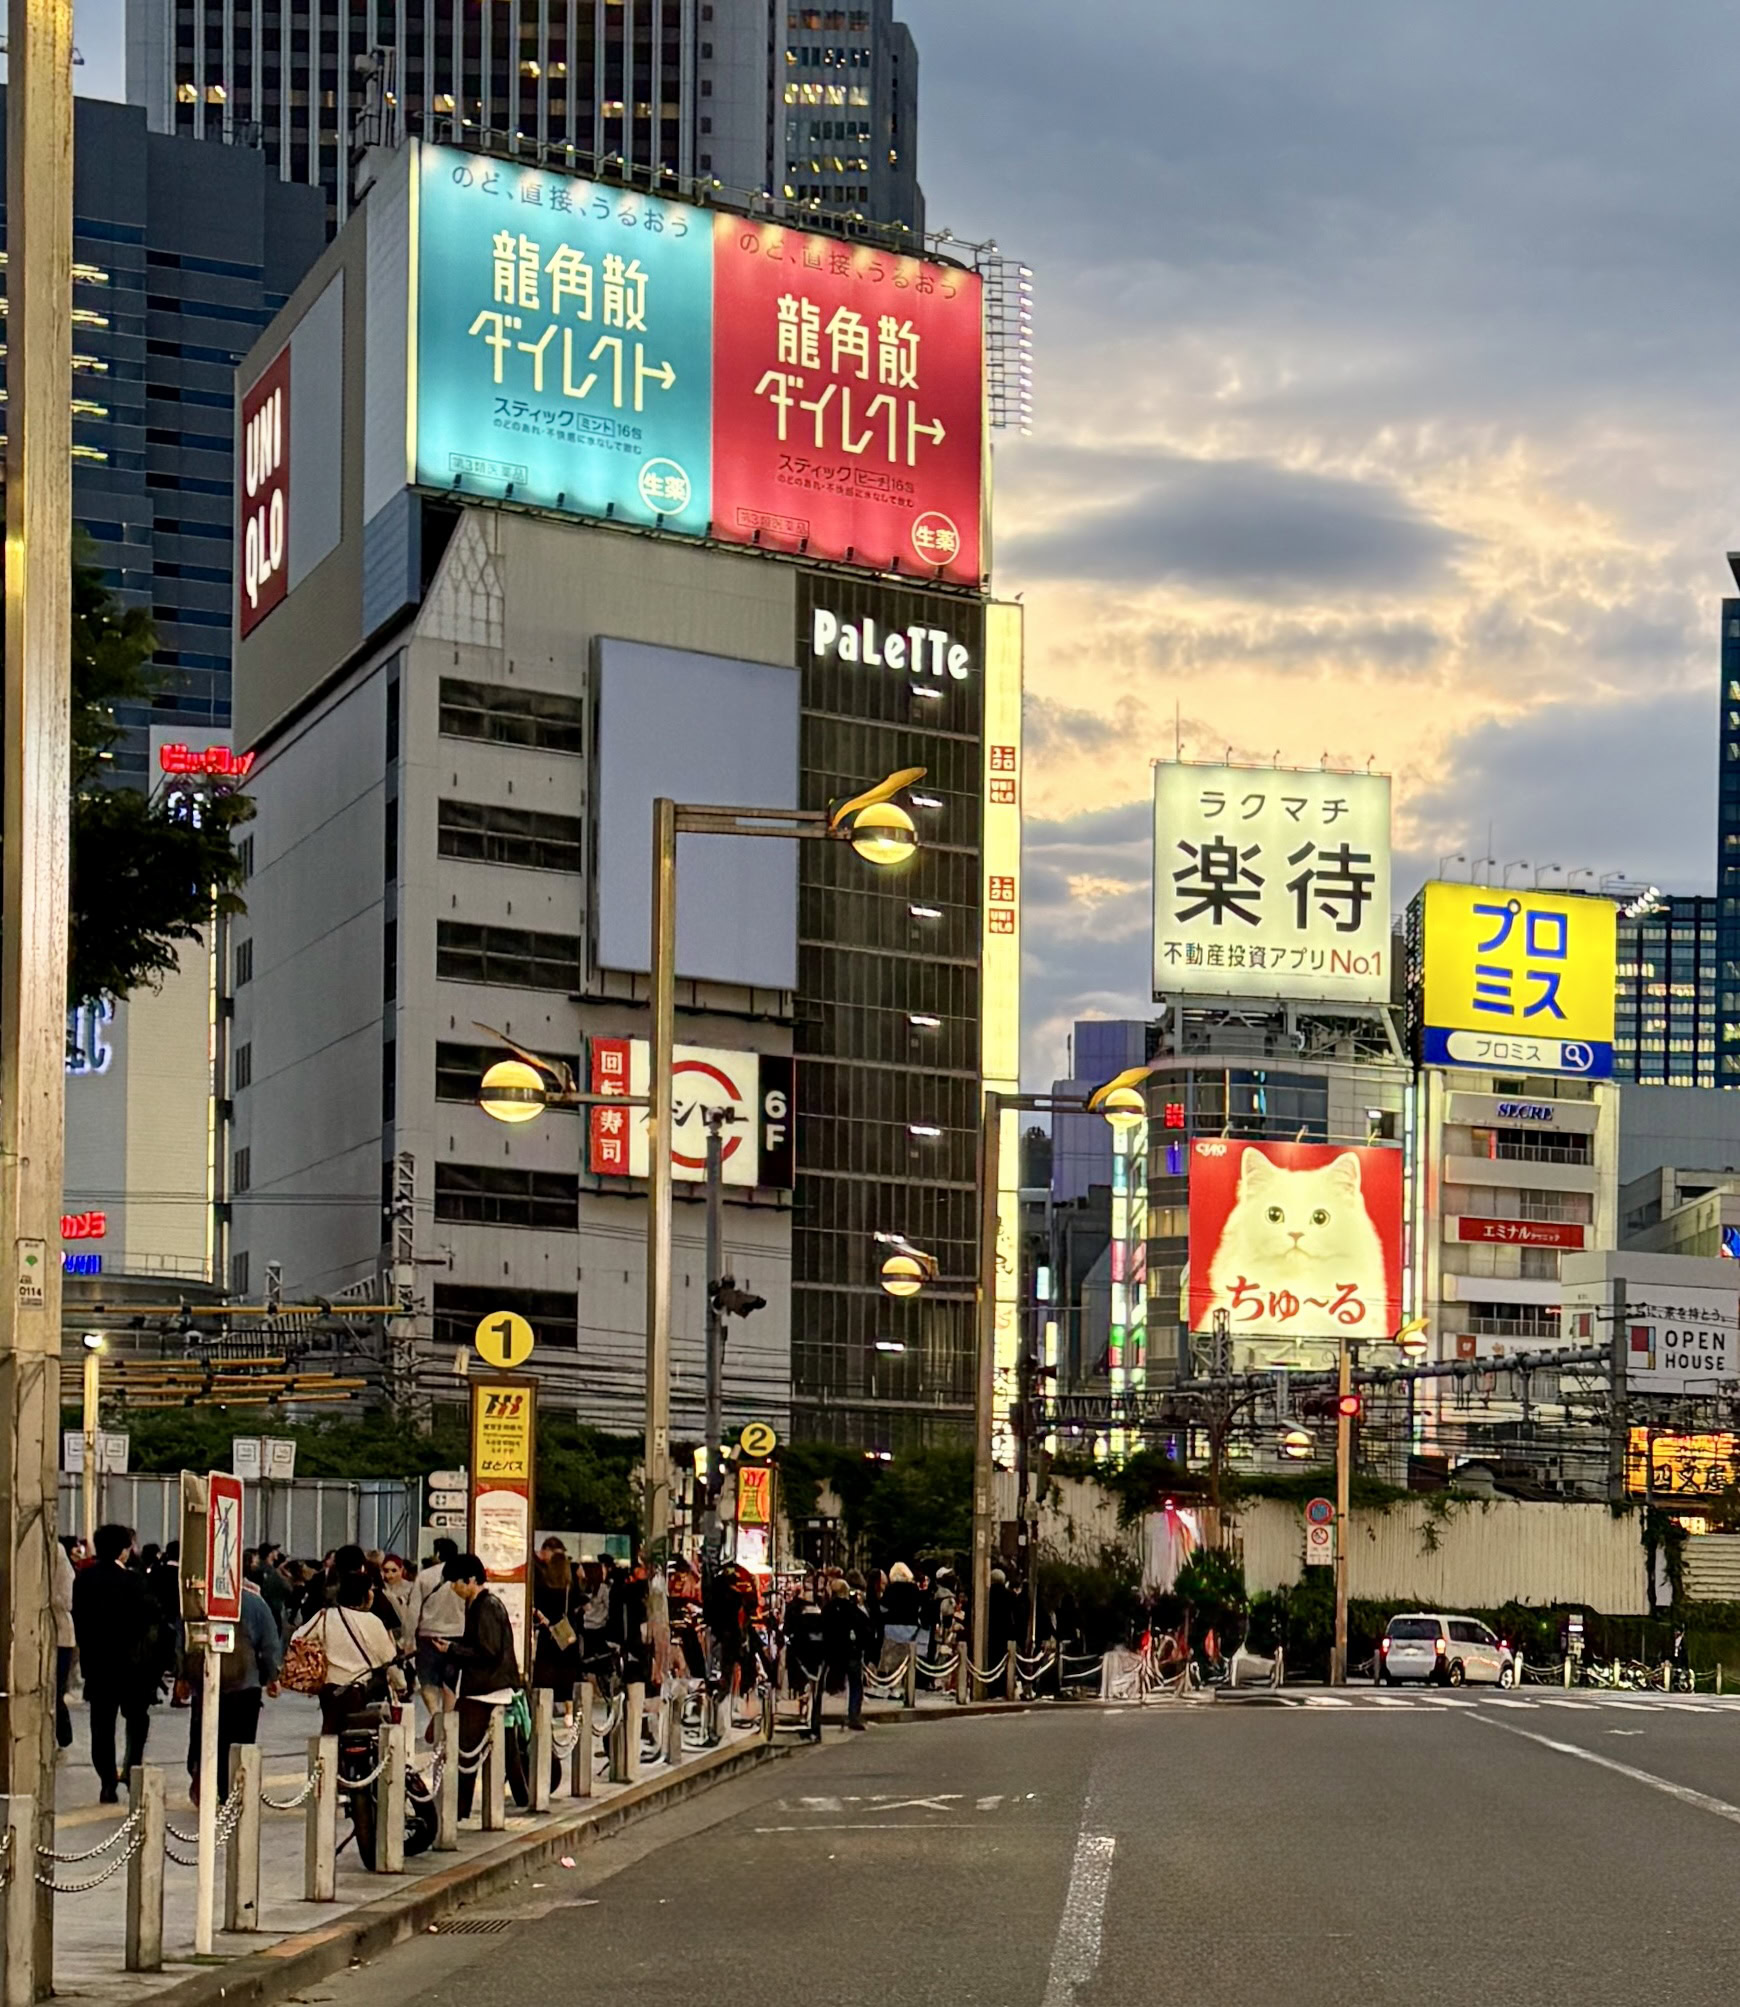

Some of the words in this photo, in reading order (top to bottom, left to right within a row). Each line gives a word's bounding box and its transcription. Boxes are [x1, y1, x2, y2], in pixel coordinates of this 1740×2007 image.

[451, 165, 689, 238] のど、直接、うるおう
[492, 229, 649, 332] 龍角散
[739, 233, 958, 300] のど、直接、うるおう
[468, 310, 677, 412] ダイレクト
[776, 293, 921, 390] 龍角散
[493, 397, 575, 427] スティック
[580, 416, 613, 433] ミント
[753, 370, 947, 467] ダイレクト
[245, 386, 282, 498] UNI
[642, 471, 687, 501] 生薬
[778, 453, 852, 482] スティック
[244, 487, 284, 609] QLO
[915, 525, 956, 552] 生薬
[1200, 791, 1350, 824] ラクマチ
[1172, 834, 1376, 933] 楽待
[1472, 898, 1569, 960] プロ
[1472, 963, 1569, 1020] ミス
[1476, 1039, 1542, 1062] プロミス
[1497, 1102, 1555, 1121] SECRE
[19, 1285, 43, 1297] 0114
[490, 1318, 513, 1360] 1
[1664, 1329, 1726, 1351] OPEN
[1664, 1352, 1726, 1371] HOUSE
[748, 1427, 768, 1451] 2
[481, 1460, 523, 1472] はとバス
